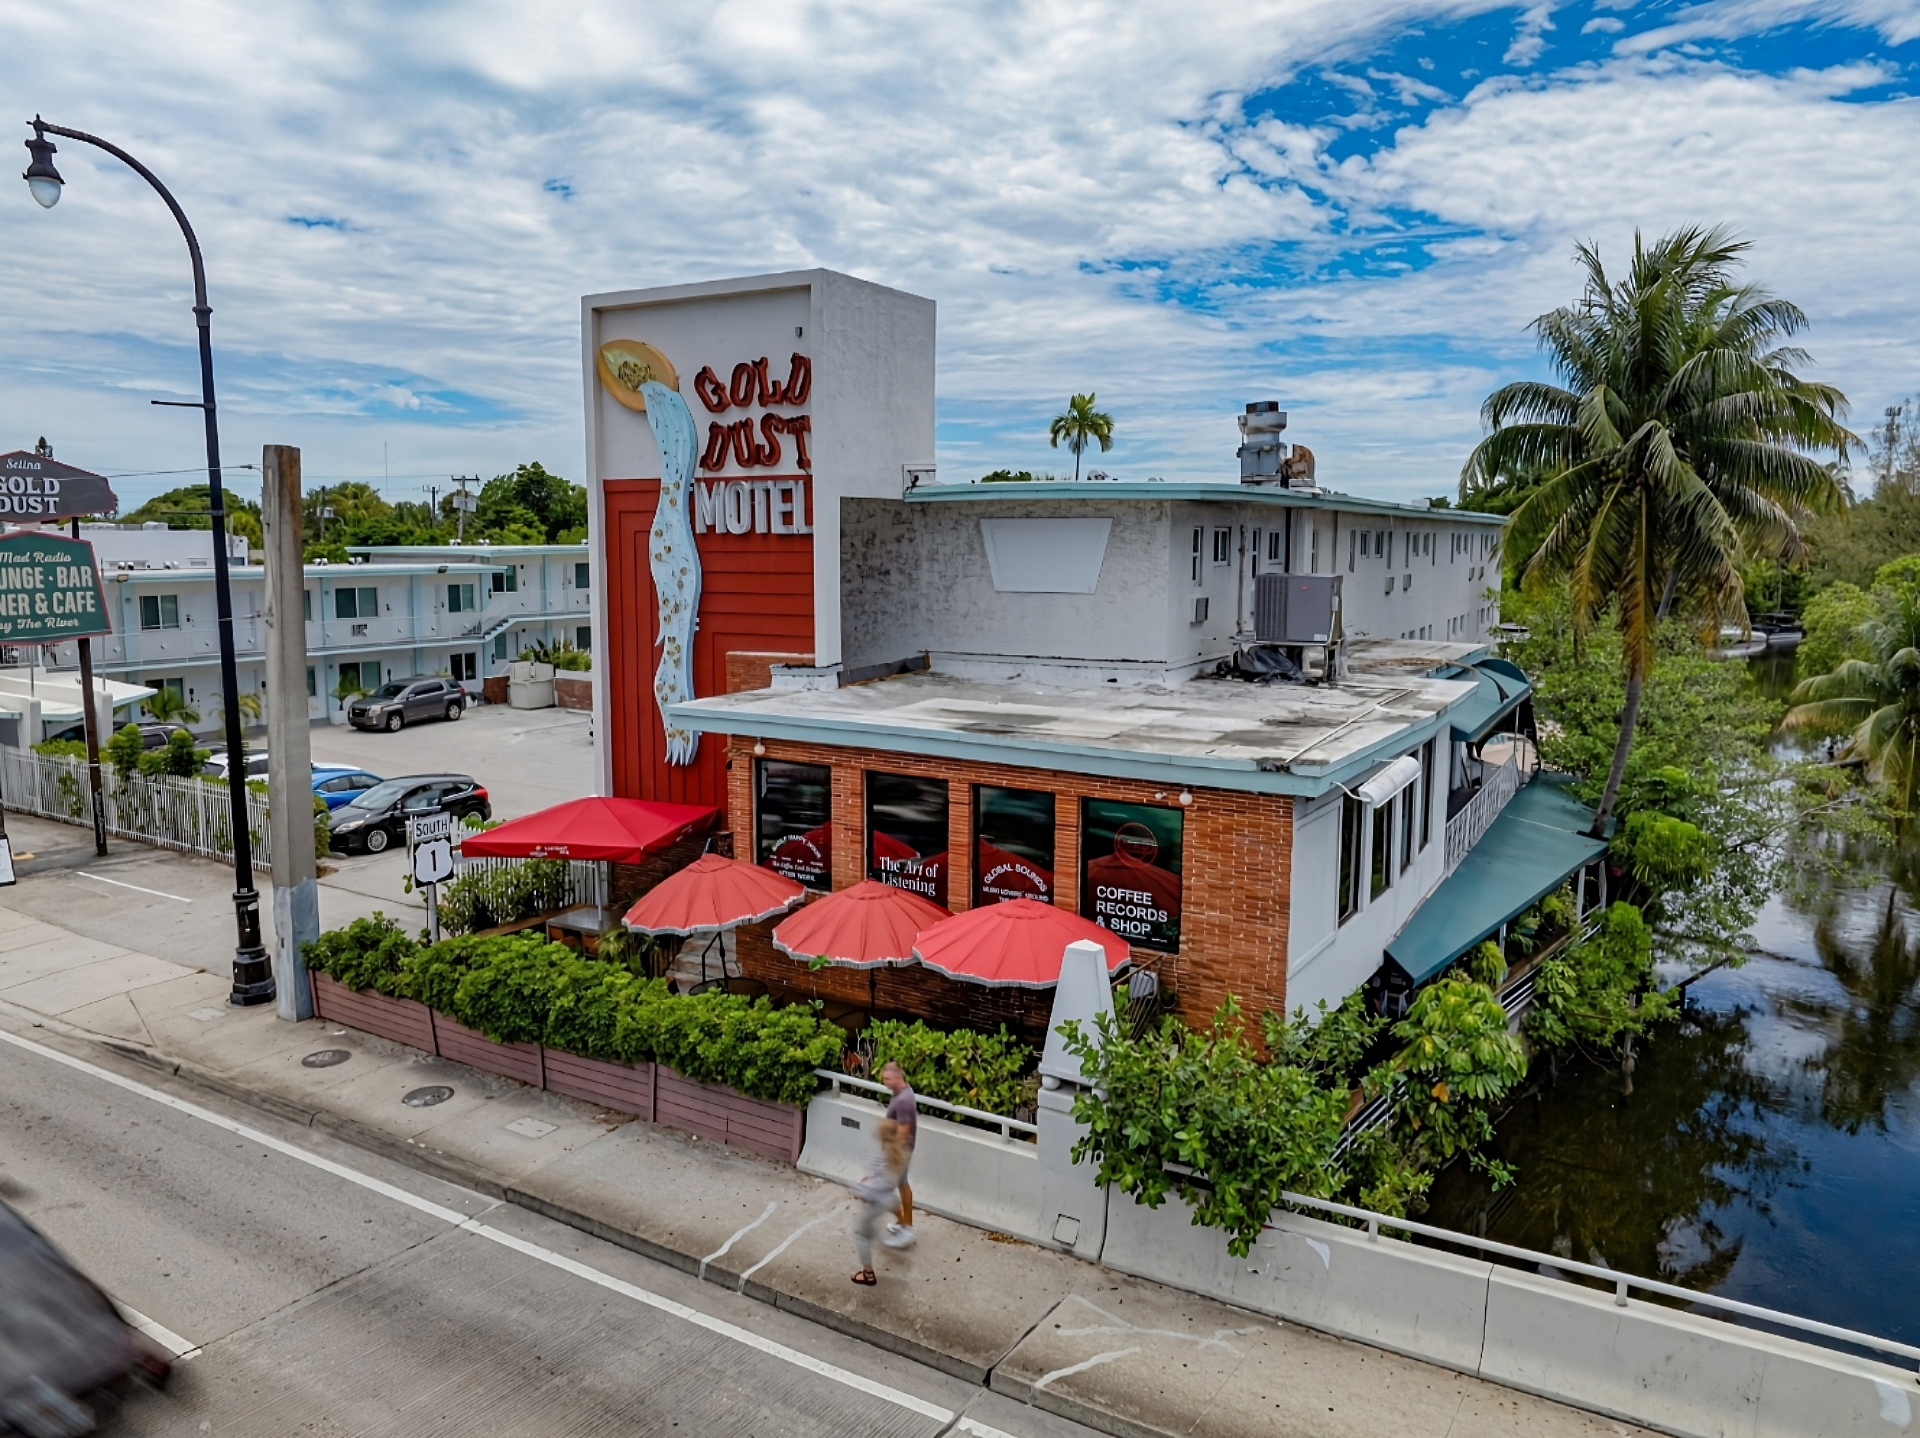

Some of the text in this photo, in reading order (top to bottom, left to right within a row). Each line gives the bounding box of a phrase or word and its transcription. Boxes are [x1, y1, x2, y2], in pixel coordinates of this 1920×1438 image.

[694, 352, 811, 412] GOLD
[699, 412, 811, 472] DUST
[6, 458, 41, 470] Selina
[694, 480, 813, 534] MOTEL
[33, 551, 72, 563] Radio
[56, 565, 93, 588] BAR
[35, 592, 49, 615] &
[52, 591, 96, 614] CAFE
[17, 618, 42, 629] The
[45, 617, 79, 628] River
[416, 819, 448, 837] SOUTH
[430, 849, 437, 872] 1
[879, 856, 939, 878] The Art of
[881, 872, 936, 897] Listening
[984, 862, 1047, 893] GLOBAL SOUNDS
[1096, 885, 1152, 905] COFFEE
[1096, 900, 1168, 923] RECORDS
[1110, 917, 1151, 935] SHOP
